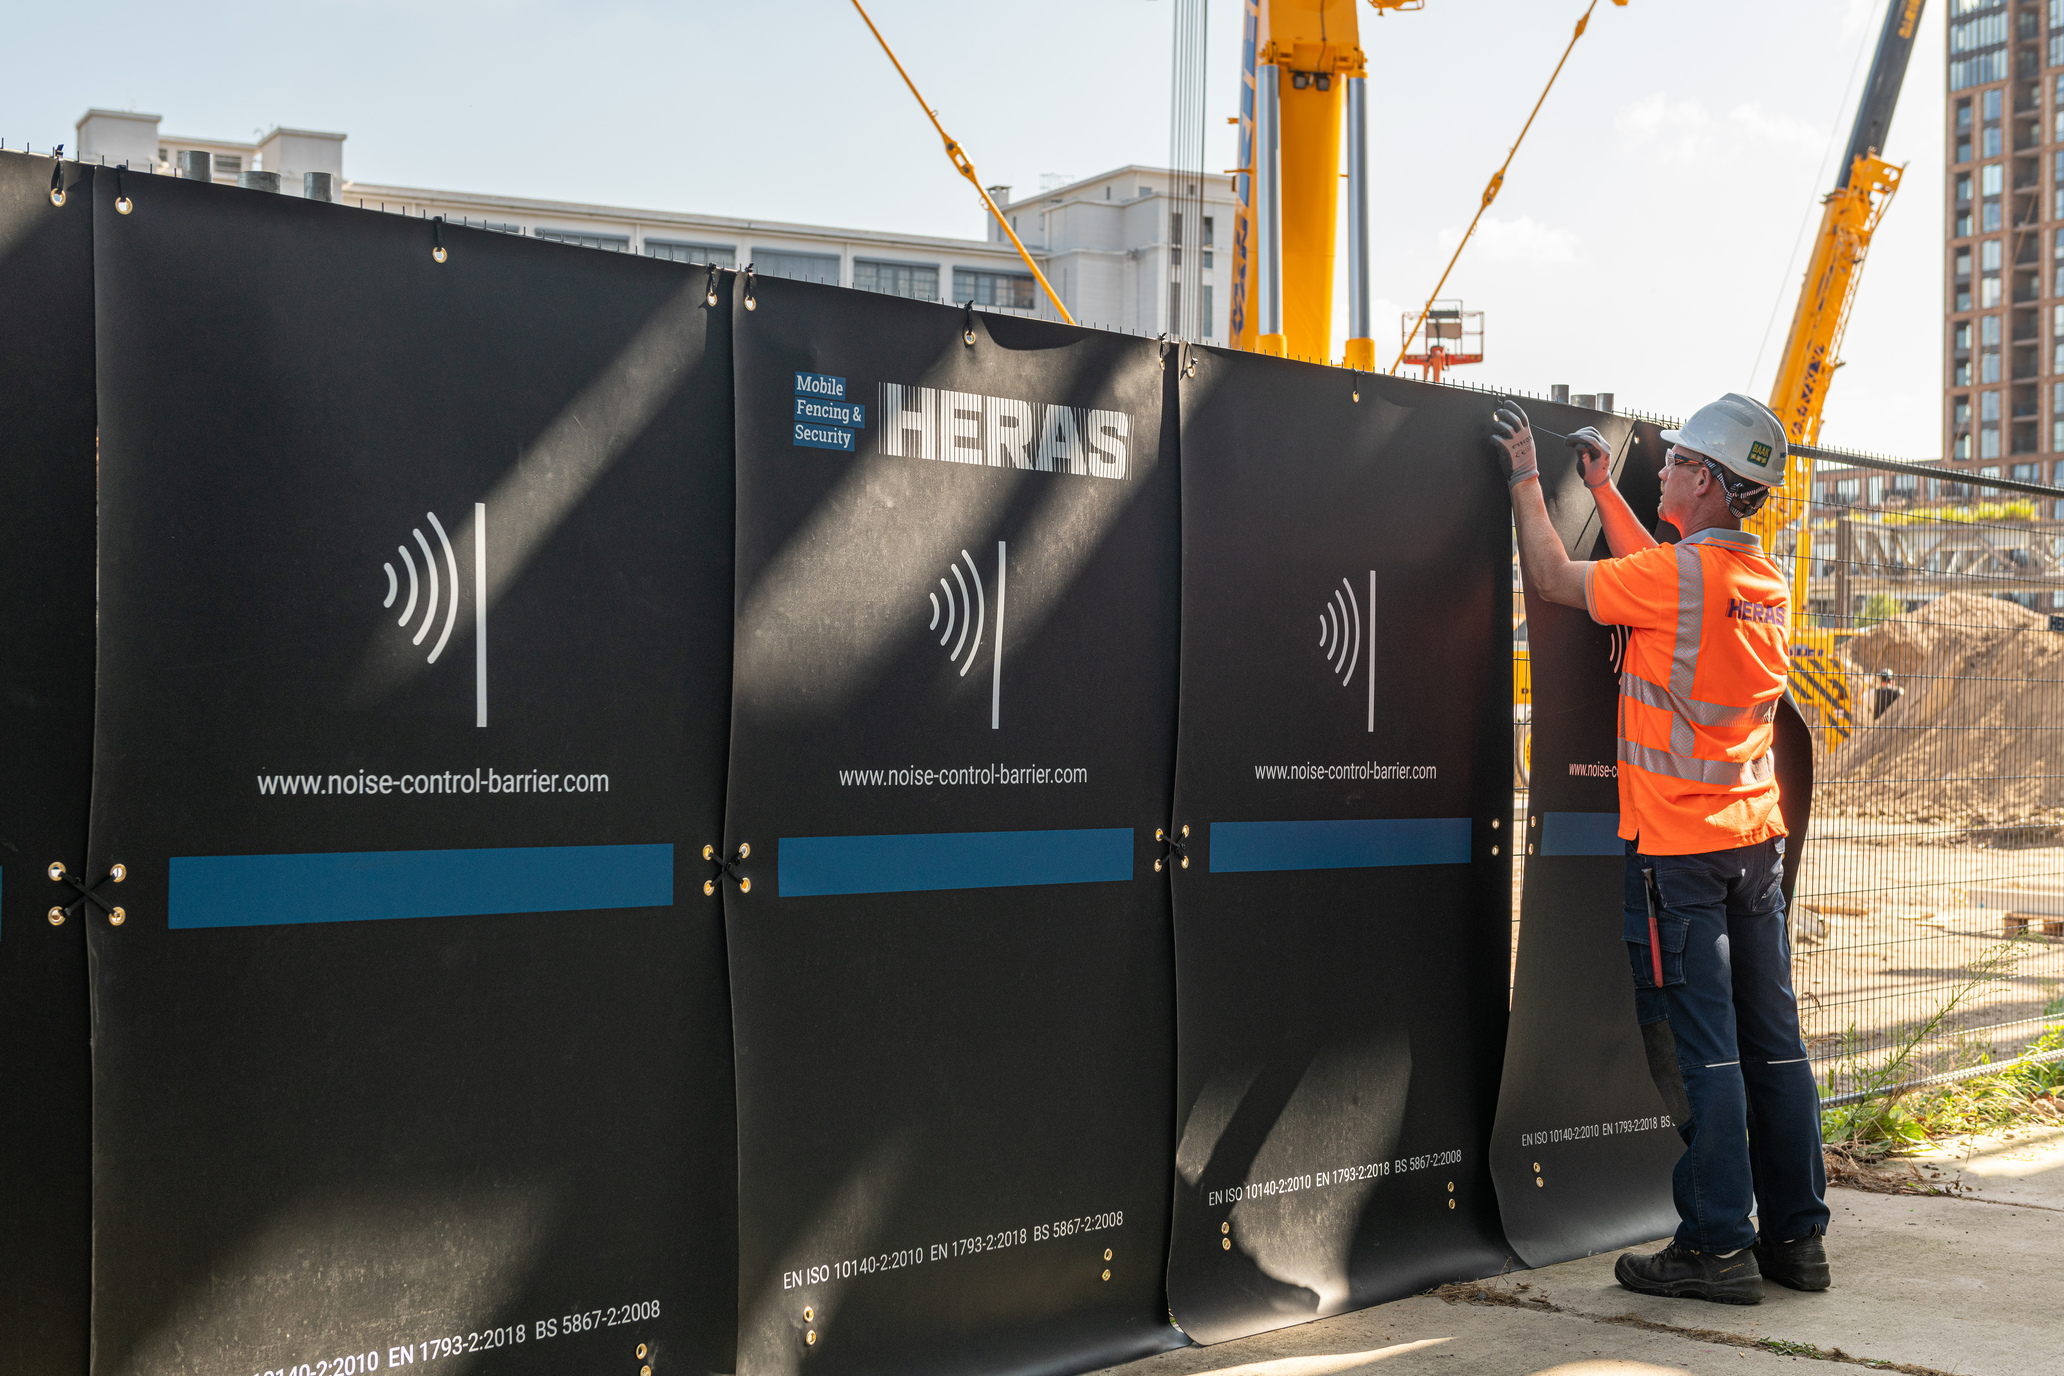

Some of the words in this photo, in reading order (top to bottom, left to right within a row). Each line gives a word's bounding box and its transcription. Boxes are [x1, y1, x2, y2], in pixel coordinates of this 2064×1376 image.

[796, 374, 844, 396] Mobile
[796, 399, 849, 424] Fencing
[852, 406, 862, 422] &
[795, 424, 852, 449] Security
[878, 381, 1135, 481] HERAS
[1725, 598, 1785, 626] HERAS
[257, 768, 609, 795] www.noise-control-barrier.com
[838, 762, 1088, 787] www.noise-control-barrier.com
[1255, 761, 1437, 780] www.noise-control-barrier.com
[1569, 761, 1618, 778] www.noise-c
[1522, 1134, 1533, 1147] EN
[1534, 1131, 1547, 1145] ISO
[1550, 1124, 1599, 1143] 10140-2:2010
[1602, 1123, 1613, 1136] EN
[1615, 1117, 1657, 1134] 1793-2:2018
[1660, 1115, 1671, 1128] BS
[1209, 1191, 1223, 1206] EN
[1225, 1187, 1243, 1202] ISO
[1246, 1174, 1311, 1200] 10140-2:2010
[1316, 1172, 1330, 1188] EN
[1332, 1162, 1390, 1184] 1793-2:2018
[1395, 1159, 1407, 1174] BS
[1410, 1149, 1462, 1171] 5867-2:2008
[783, 1270, 802, 1289] EN
[806, 1265, 830, 1285] ISO
[834, 1248, 923, 1279] 10140-2:2010
[931, 1243, 948, 1261] EN
[952, 1228, 1027, 1257] 1793-2:2018
[1034, 1225, 1050, 1242] BS
[1053, 1211, 1124, 1238] 5867-2:2008
[388, 1344, 415, 1368] EN
[419, 1324, 526, 1362] 1793-2:2018
[535, 1318, 558, 1340] BS
[562, 1300, 661, 1332] 5867-2:2008
